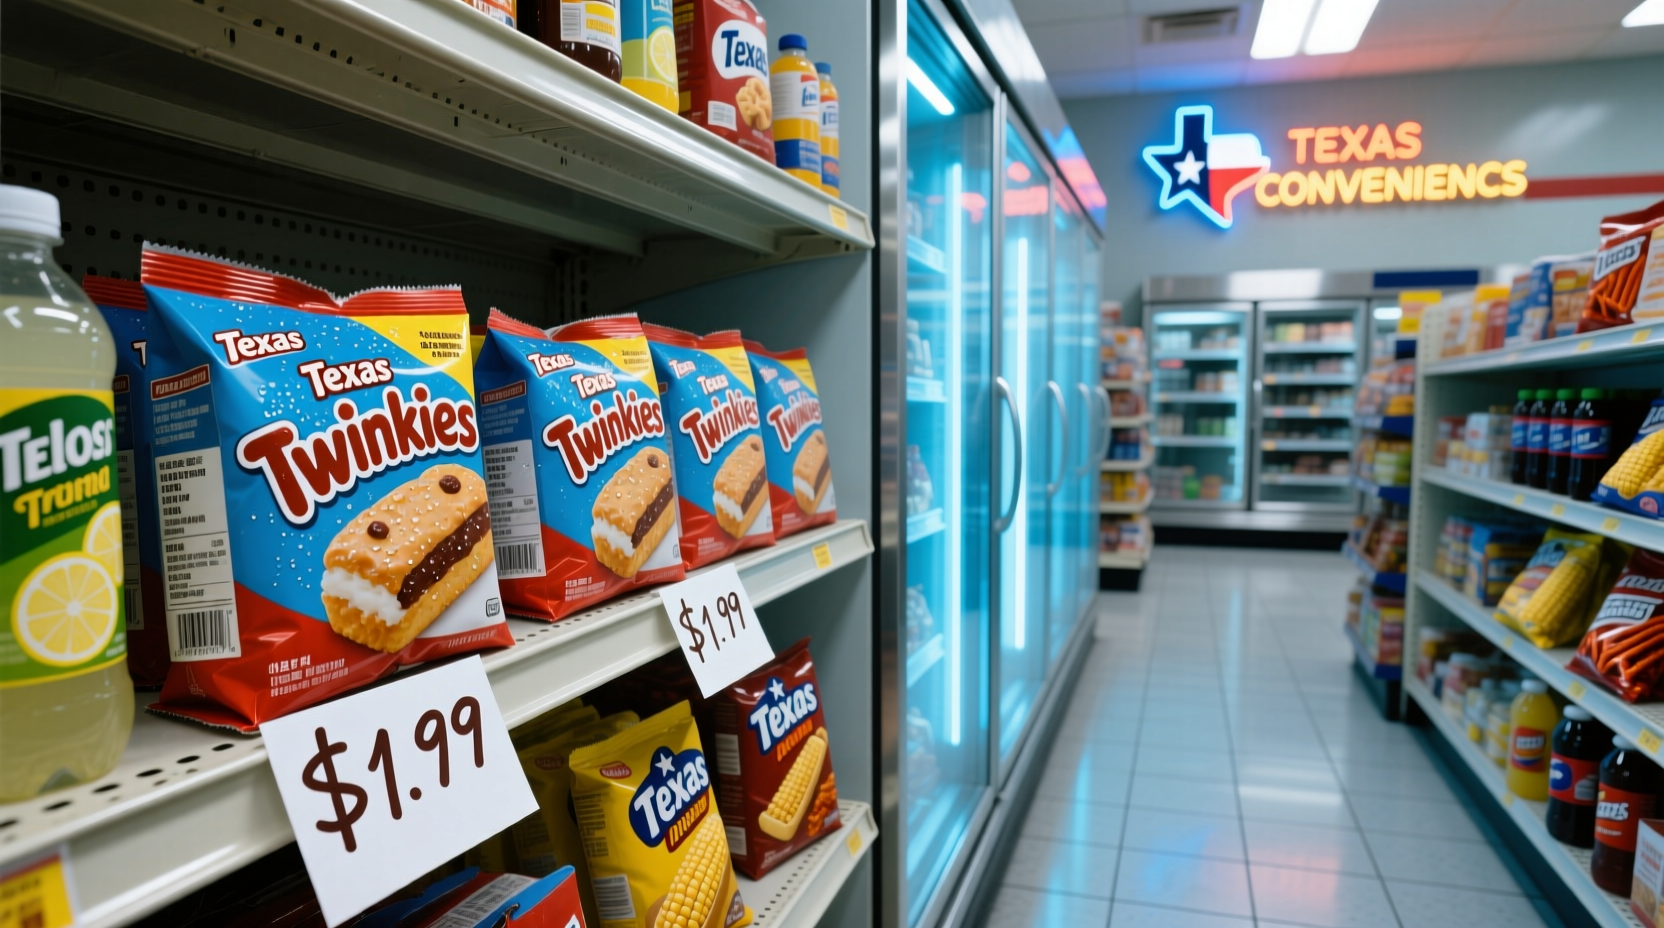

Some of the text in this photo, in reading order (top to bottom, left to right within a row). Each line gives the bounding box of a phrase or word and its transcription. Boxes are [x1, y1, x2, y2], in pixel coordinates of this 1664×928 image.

[1287, 121, 1423, 164] TEXAS
[1254, 160, 1529, 208] CONVENIENCS
[214, 330, 304, 363] Texas
[300, 359, 392, 398] Texas
[528, 353, 575, 376] Texas
[241, 384, 479, 519] Twinkies
[545, 389, 665, 481] Twinkies
[681, 388, 761, 461] Twinkies
[679, 591, 746, 664] $1.99
[750, 683, 817, 752] Texas
[302, 696, 484, 853] $1.99
[634, 755, 710, 839] Texas
